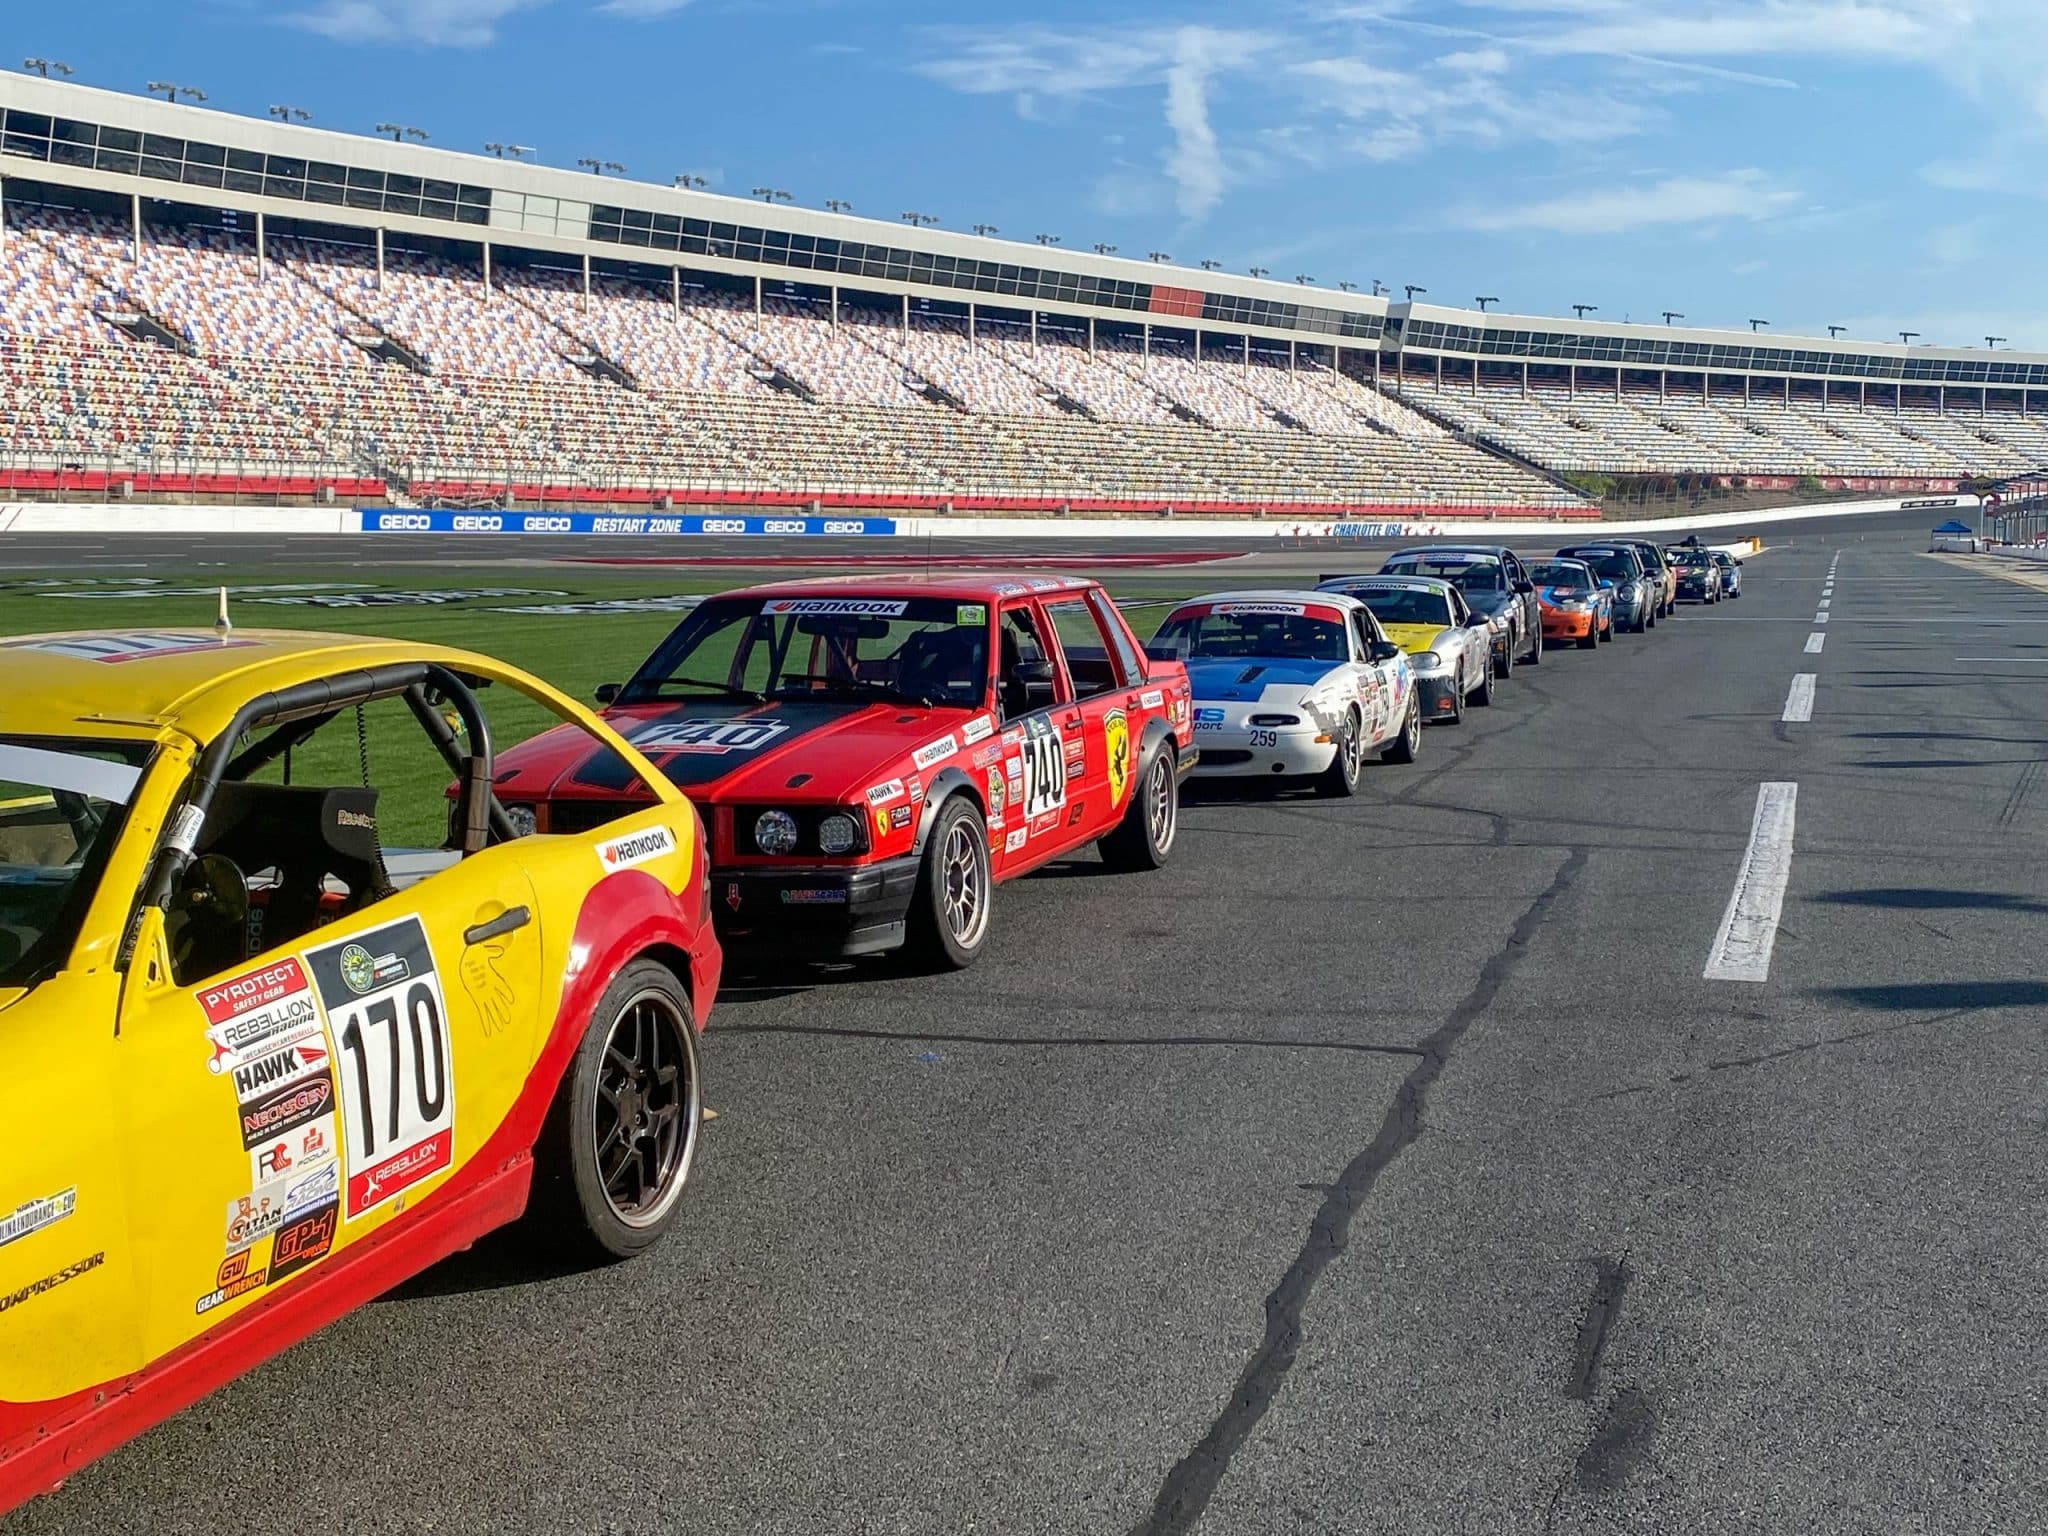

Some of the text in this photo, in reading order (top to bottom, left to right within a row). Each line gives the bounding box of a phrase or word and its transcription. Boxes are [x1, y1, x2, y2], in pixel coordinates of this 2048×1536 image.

[379, 515, 430, 529] GEICO
[453, 516, 502, 530] GEICO
[524, 517, 571, 531] GEICO
[592, 518, 681, 533] RESTART ZONE
[702, 519, 745, 532] GEICO
[763, 520, 806, 533] GEICO
[823, 520, 864, 533] GEICO
[1333, 524, 1402, 536] CHARLOTTE USA
[633, 725, 773, 746] 740
[1250, 730, 1277, 747] 259
[1023, 734, 1064, 814] 740
[205, 963, 296, 1009] PYROTECT
[232, 985, 285, 1013] SAFETY GEAR
[224, 998, 314, 1044] REBELLION
[235, 1047, 298, 1095] HAWK
[342, 981, 445, 1159] 170
[296, 1147, 330, 1167] PODIUM
[17, 1200, 55, 1231] ENDURANCE
[63, 1191, 76, 1211] CUP
[234, 1207, 283, 1235] TITAN
[265, 1215, 282, 1230] TANKS
[275, 1208, 334, 1264] GP-1
[302, 1239, 330, 1259] DRIVEN
[196, 1270, 265, 1312] GEARWRENCH
